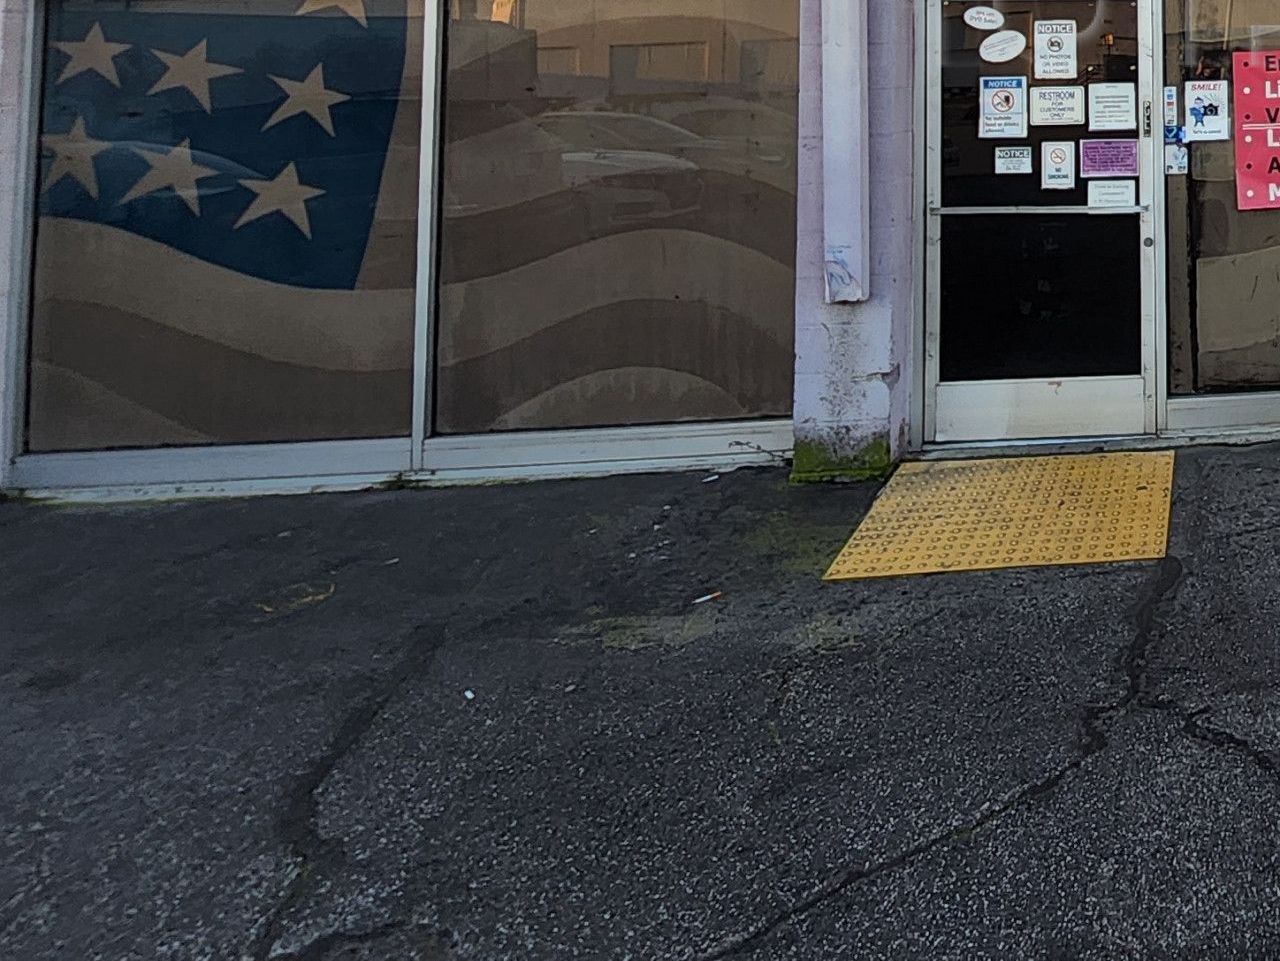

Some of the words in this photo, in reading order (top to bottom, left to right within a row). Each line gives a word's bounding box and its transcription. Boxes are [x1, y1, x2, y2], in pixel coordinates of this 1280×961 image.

[1038, 24, 1073, 34] NOTICE
[1039, 91, 1075, 99] RESTROOM
[997, 150, 1030, 158] NOTICE
